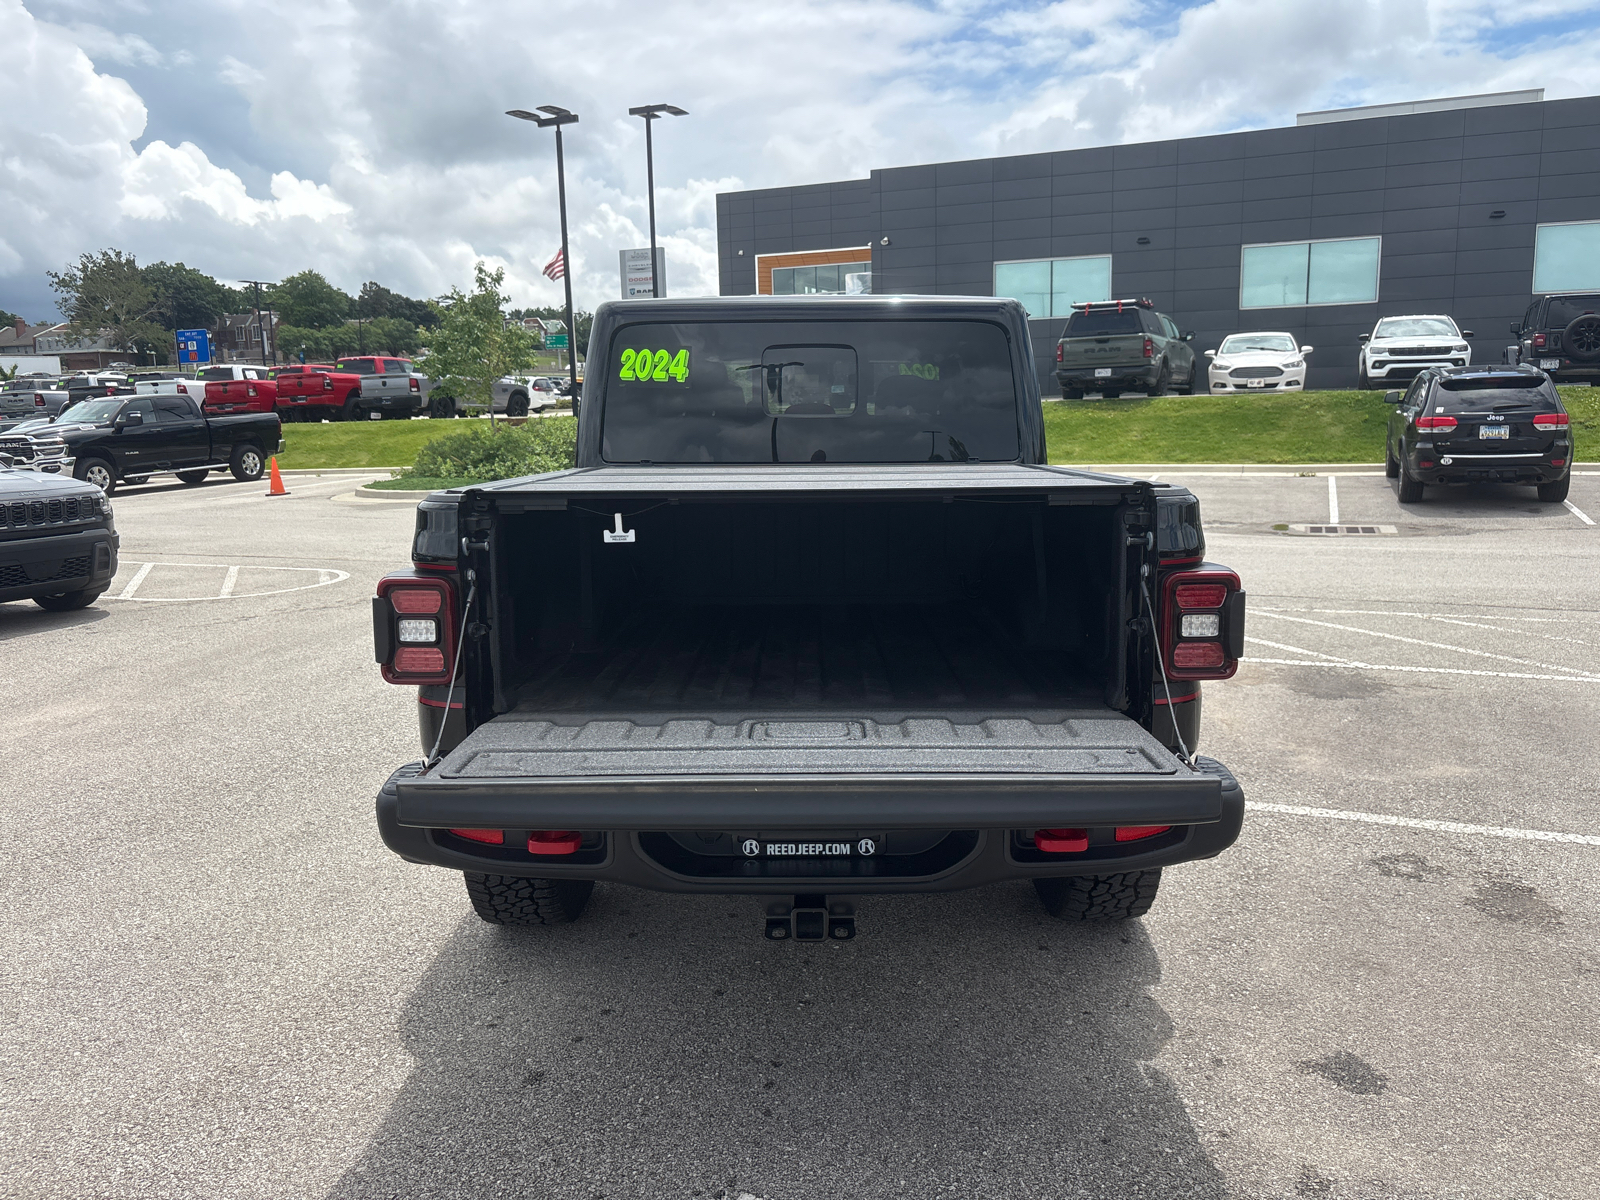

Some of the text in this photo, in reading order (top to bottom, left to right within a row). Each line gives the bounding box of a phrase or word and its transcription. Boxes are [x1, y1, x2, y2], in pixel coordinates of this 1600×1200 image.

[1083, 346, 1121, 354] RAM
[619, 348, 690, 383] 2024
[766, 843, 851, 855] REEDJEEP.COM
